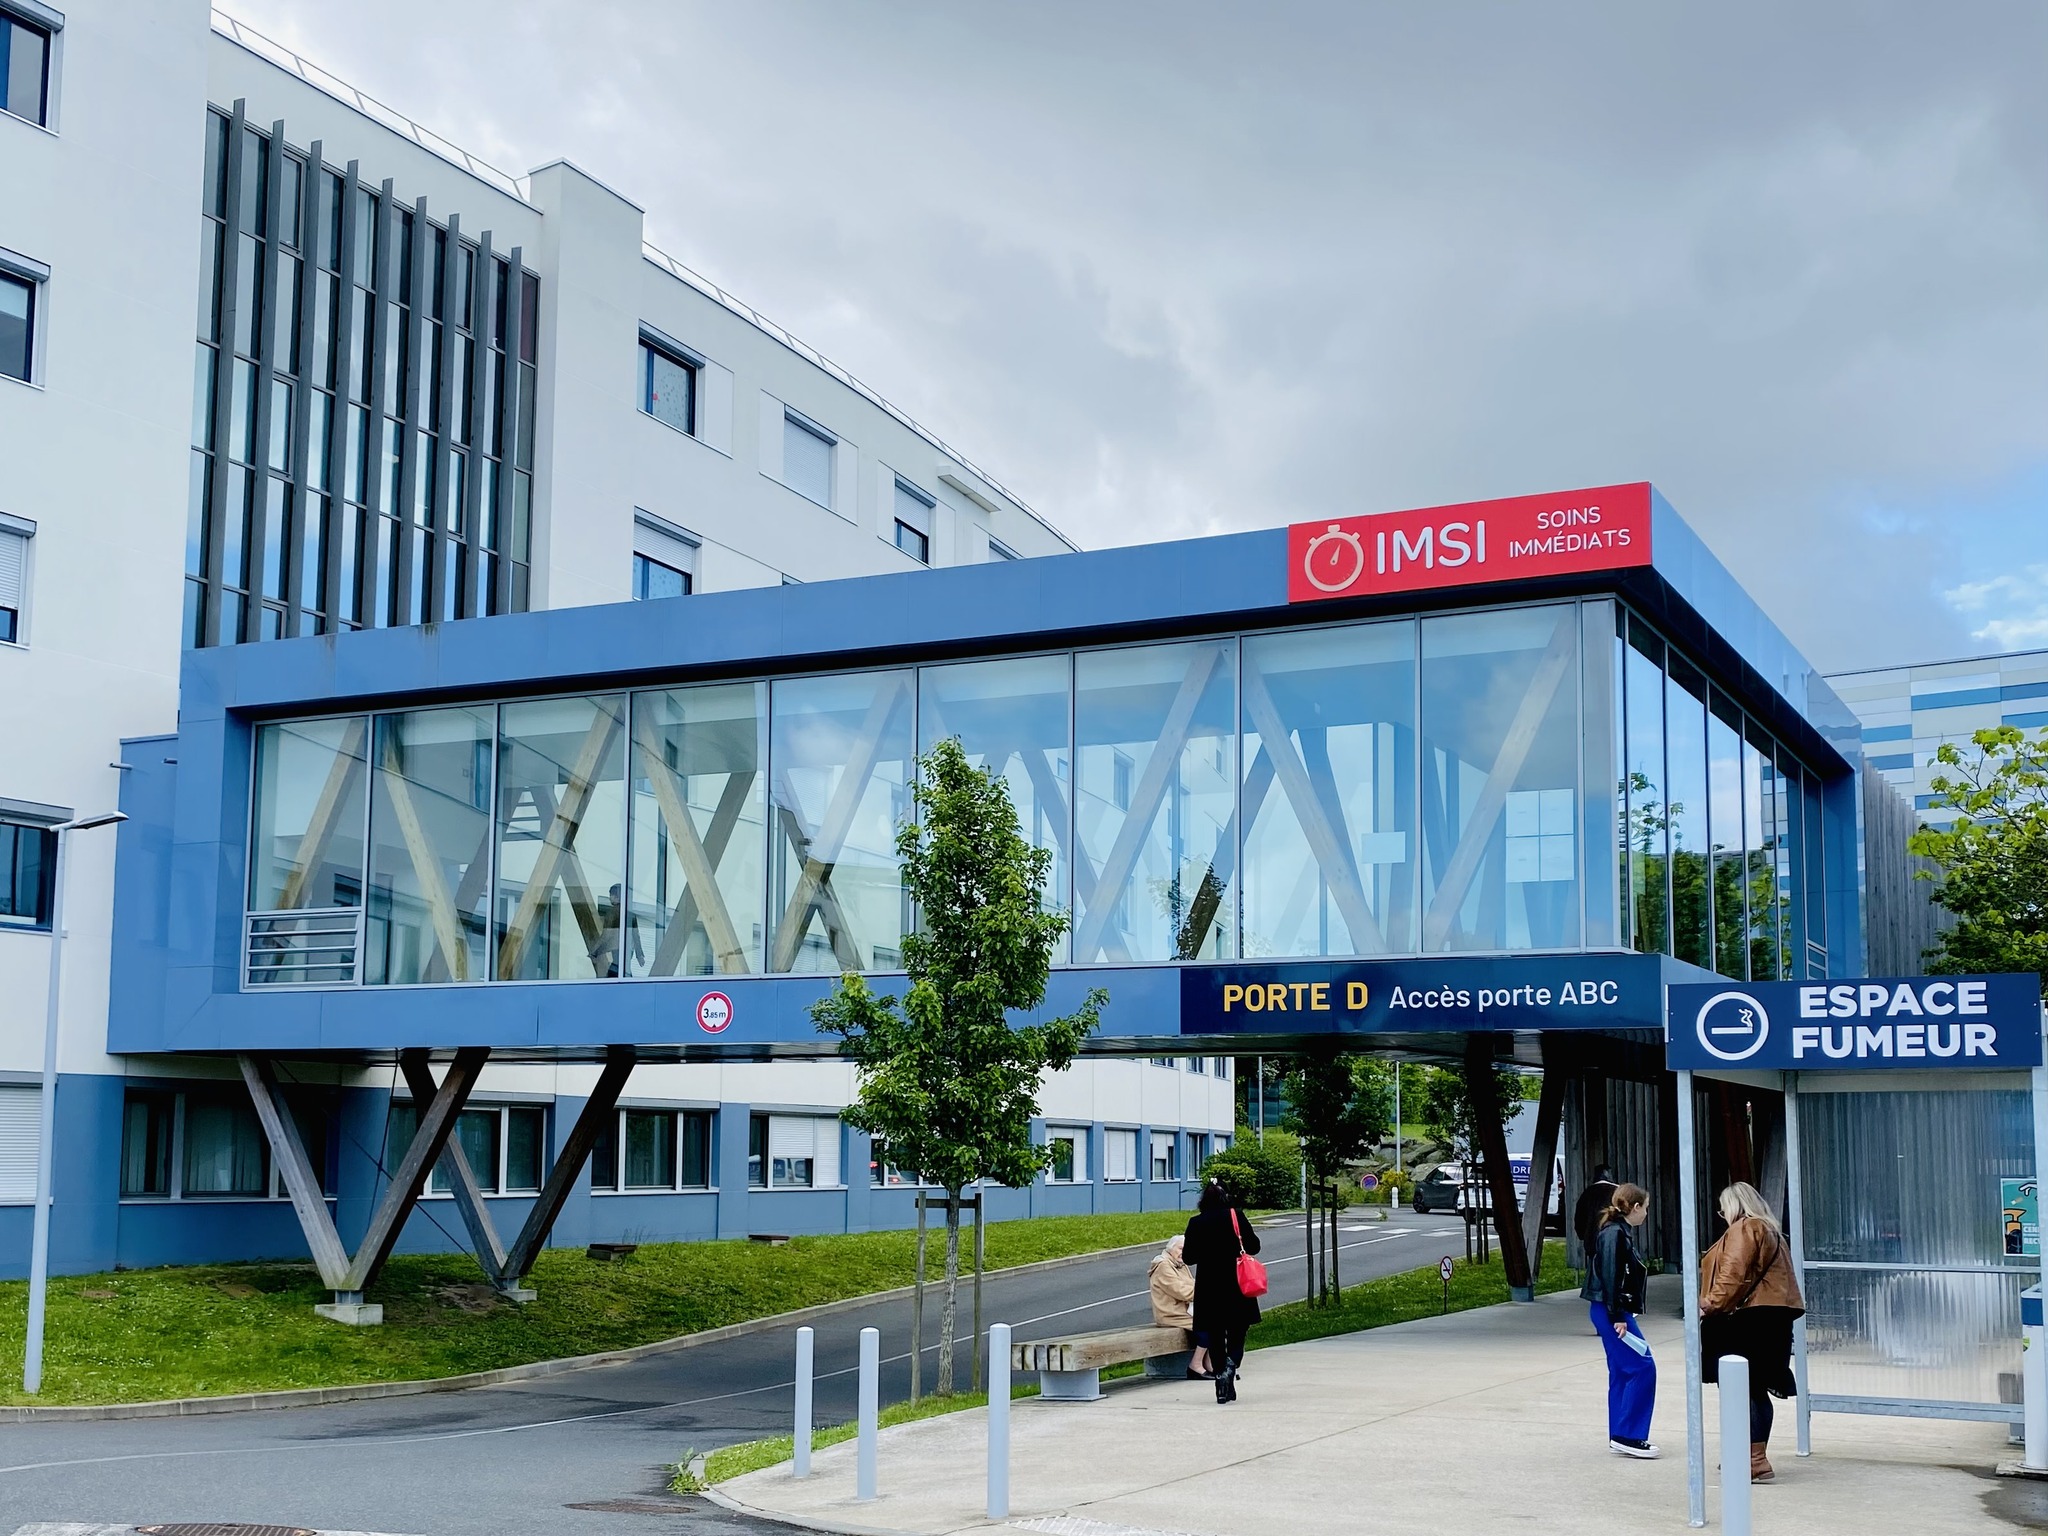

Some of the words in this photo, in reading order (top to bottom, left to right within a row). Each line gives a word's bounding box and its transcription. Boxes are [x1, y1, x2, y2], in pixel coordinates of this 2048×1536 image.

[1537, 506, 1602, 530] SOINS
[1376, 519, 1487, 575] IMSI
[1509, 523, 1631, 559] IMMÉDIATS
[1223, 982, 1331, 1012] PORTE
[1346, 981, 1368, 1011] D
[1389, 984, 1471, 1009] Accès
[1478, 983, 1552, 1013] porte
[1559, 980, 1618, 1006] ABC
[1799, 981, 1988, 1018] ESPACE
[1793, 1023, 1998, 1059] FUMEUR
